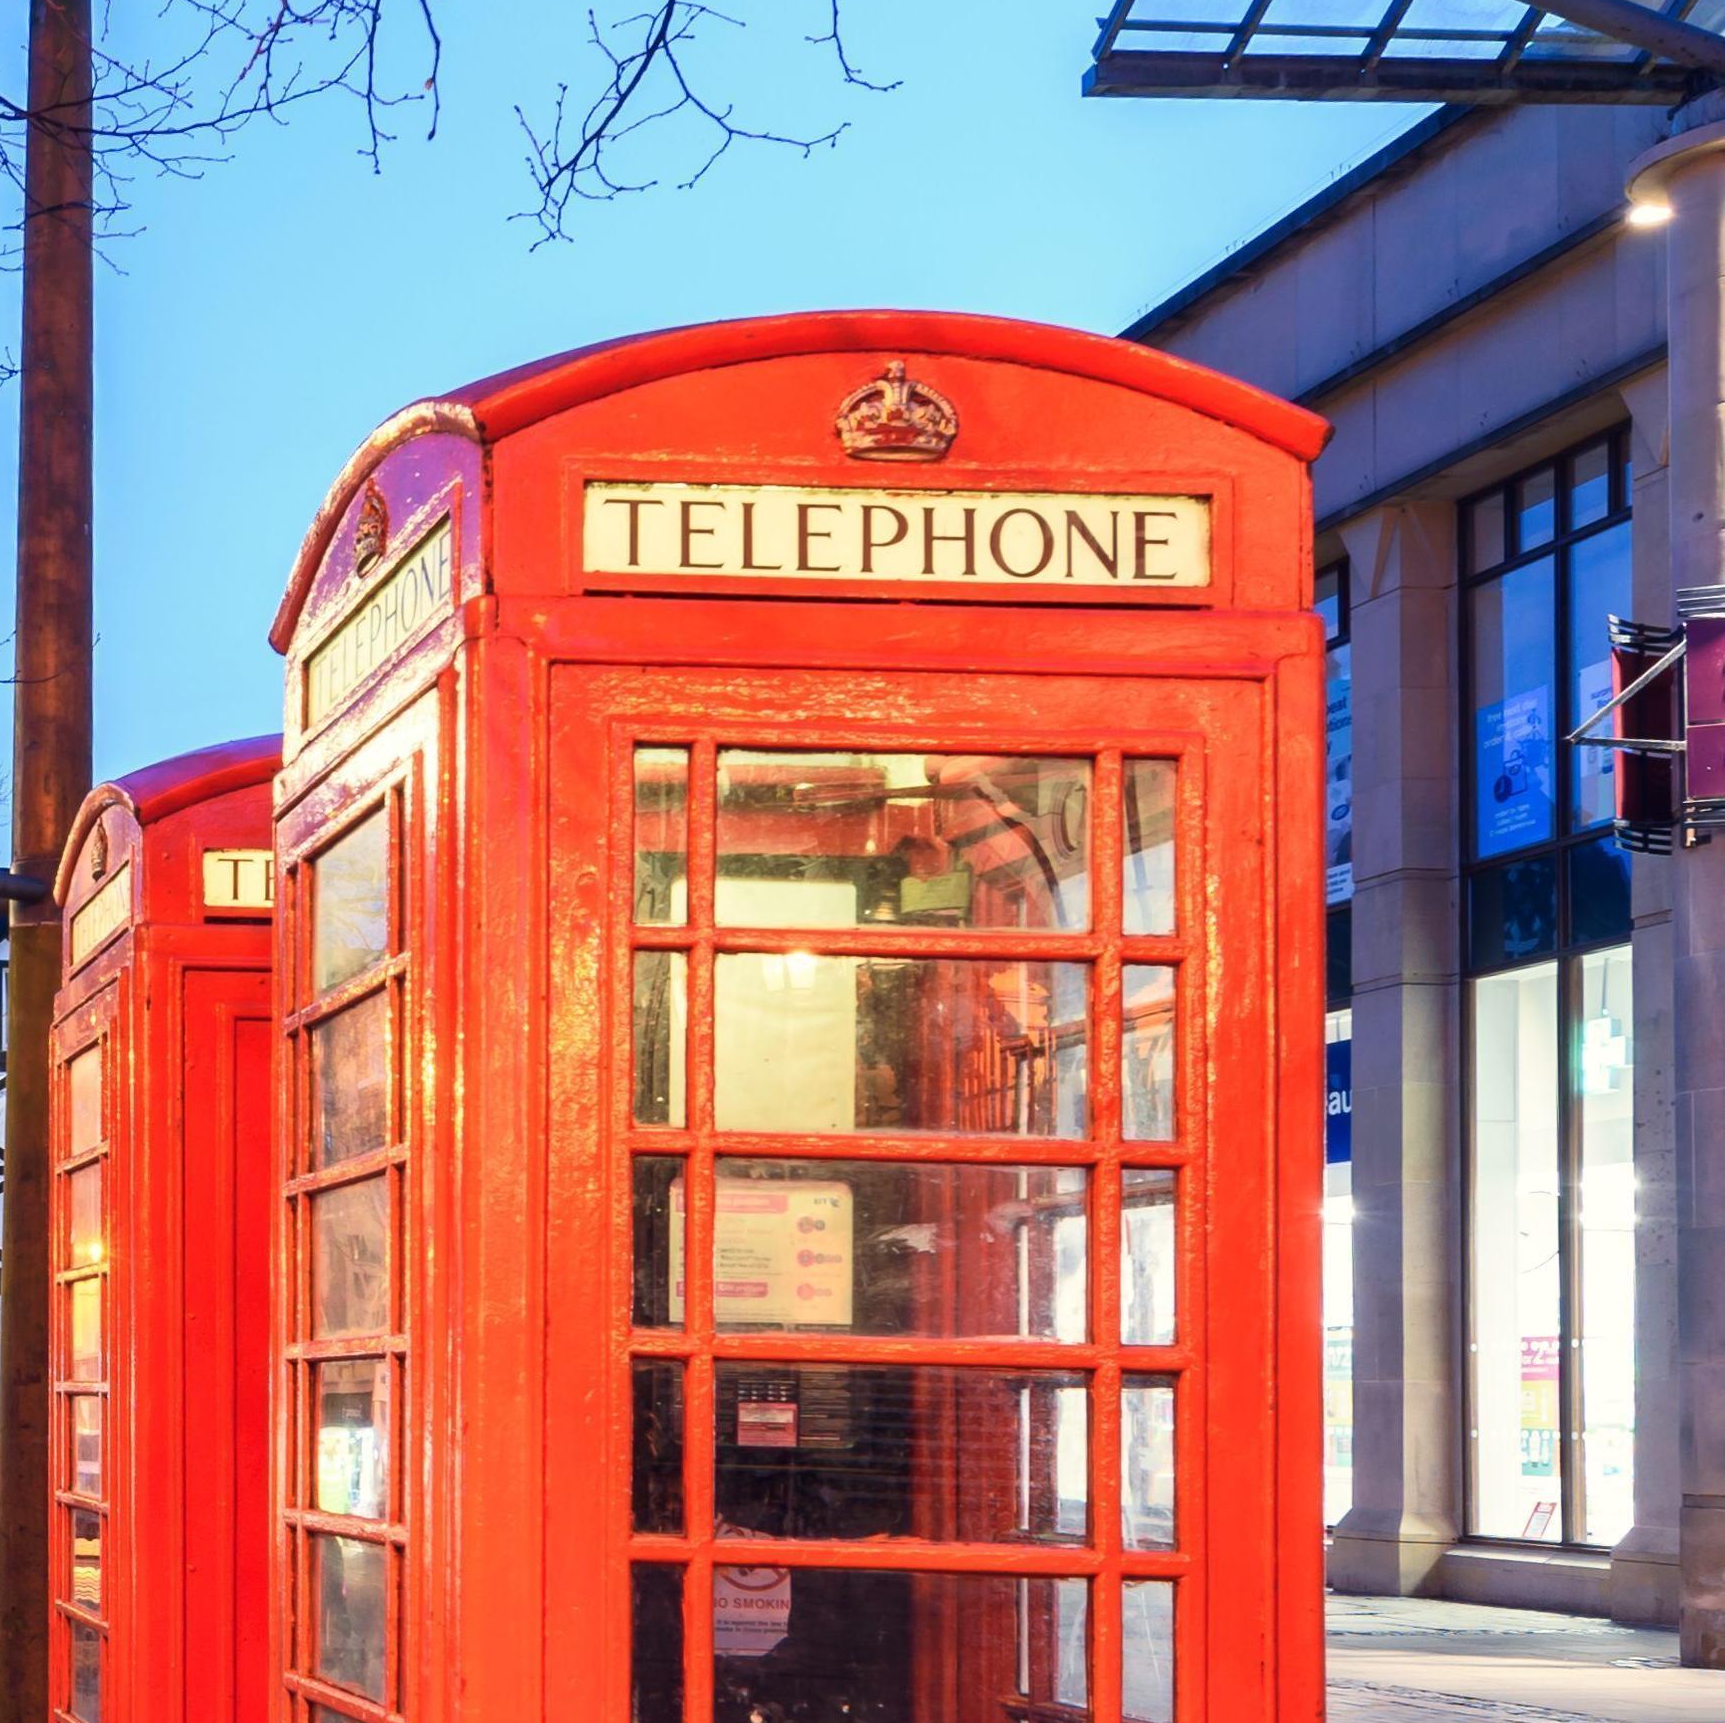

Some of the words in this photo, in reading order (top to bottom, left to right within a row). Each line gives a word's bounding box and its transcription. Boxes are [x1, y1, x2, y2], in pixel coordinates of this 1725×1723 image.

[603, 498, 1178, 581] TELEPHONE
[315, 530, 452, 705] TELEPHONE
[1328, 1090, 1352, 1115] au
[733, 1598, 789, 1610] SMOKIN
